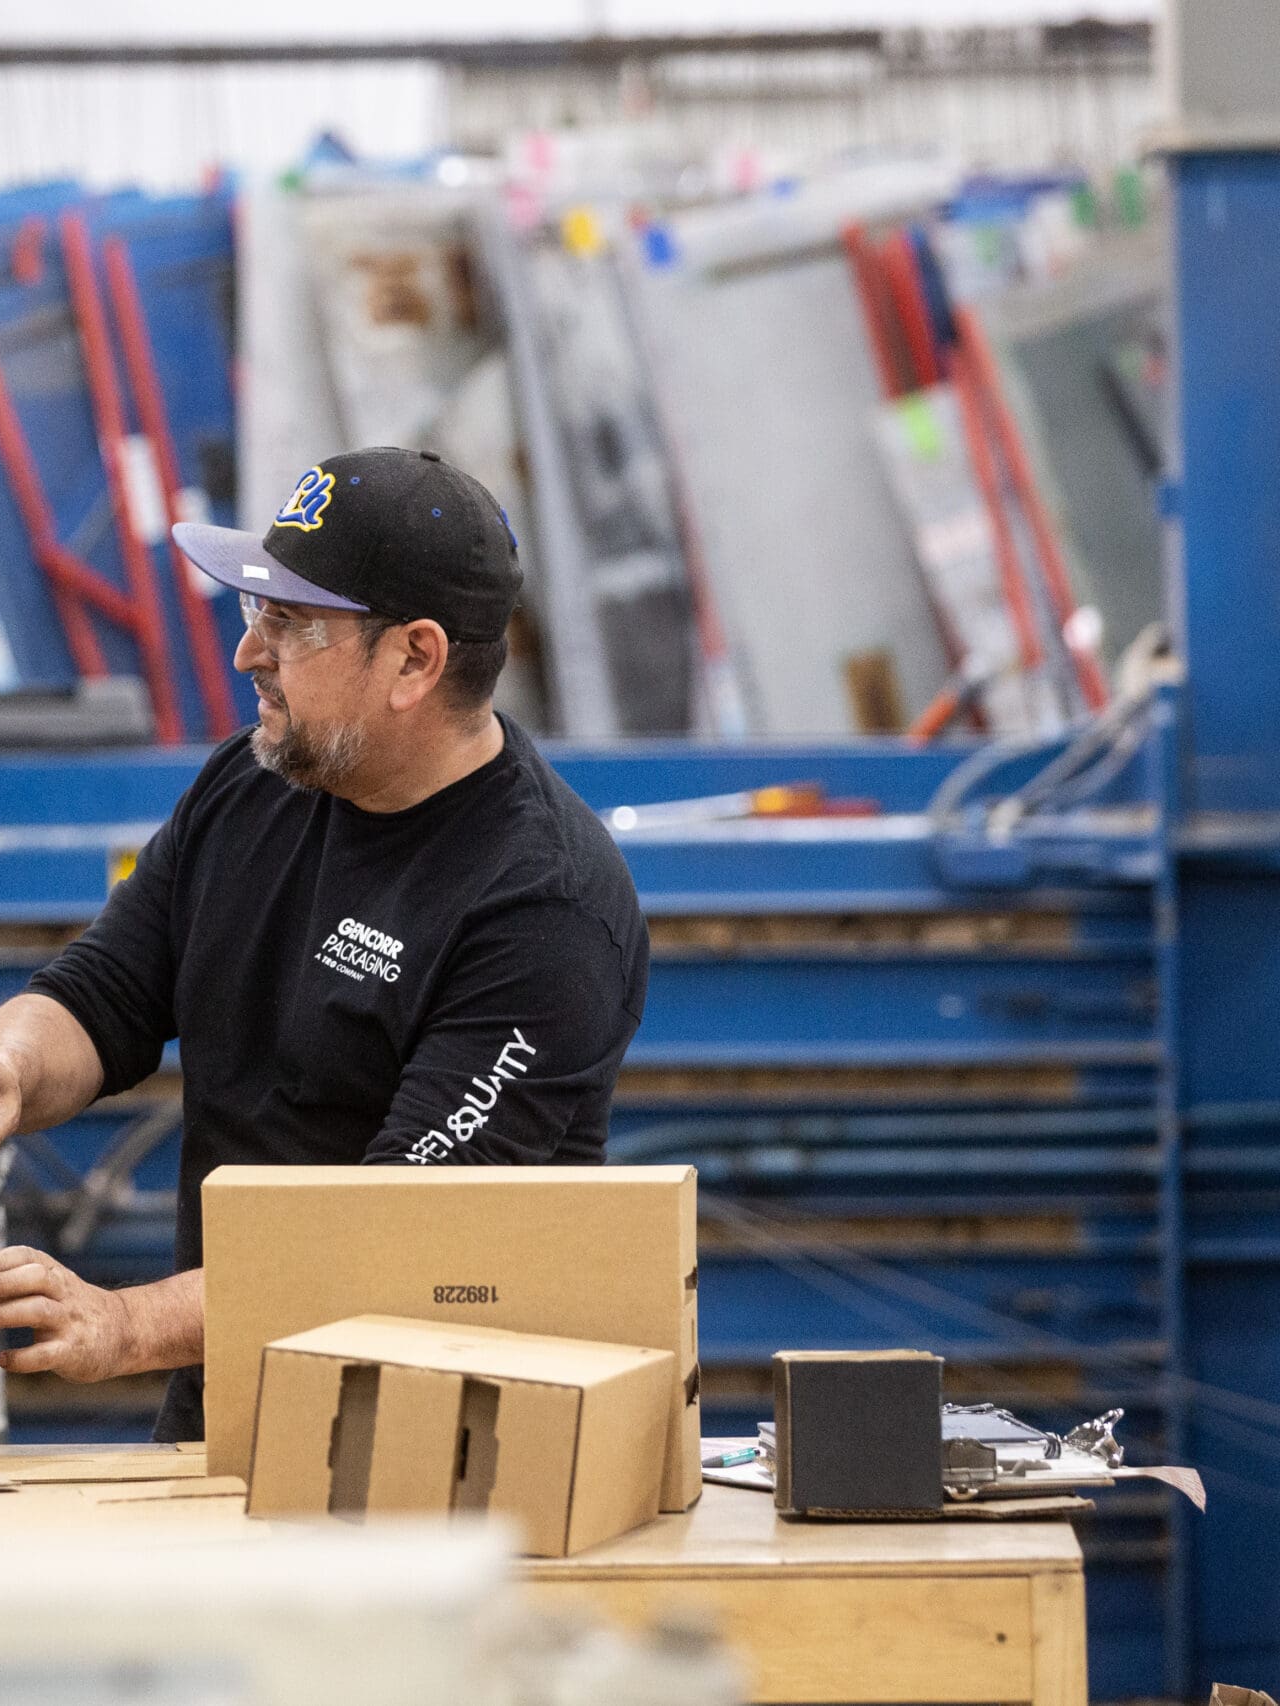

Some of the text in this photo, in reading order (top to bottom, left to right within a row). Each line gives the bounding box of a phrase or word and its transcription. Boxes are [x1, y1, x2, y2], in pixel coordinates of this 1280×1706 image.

[337, 917, 404, 960] GENCORR
[314, 953, 322, 961] A
[335, 963, 365, 981] COMPANY
[322, 934, 401, 983] PACKAGING
[433, 1285, 499, 1303] 189228
